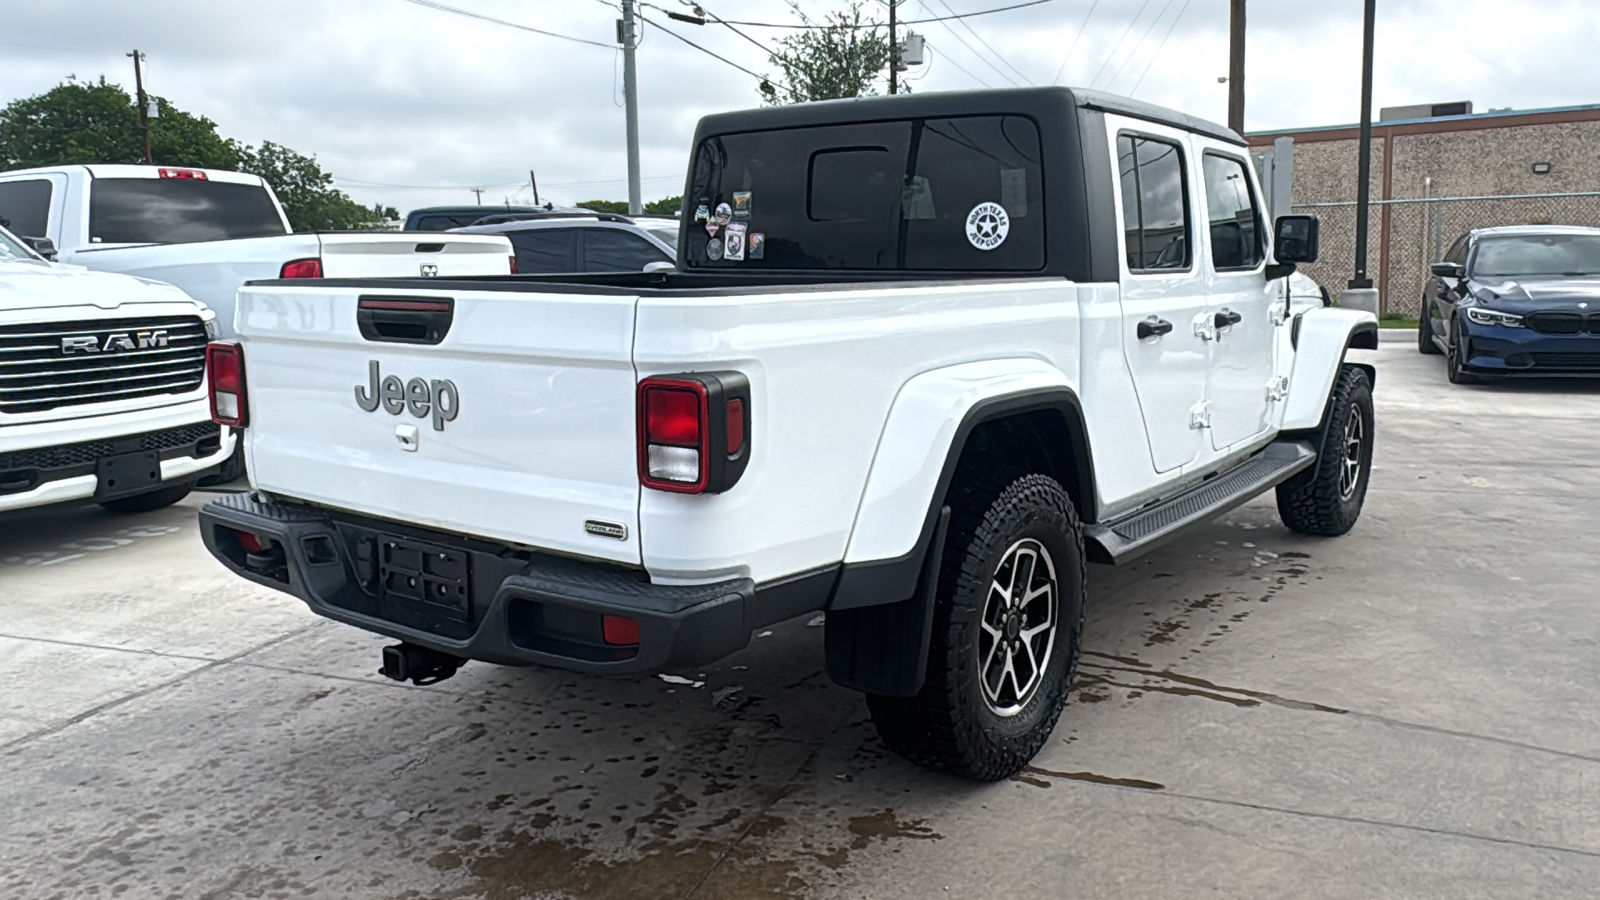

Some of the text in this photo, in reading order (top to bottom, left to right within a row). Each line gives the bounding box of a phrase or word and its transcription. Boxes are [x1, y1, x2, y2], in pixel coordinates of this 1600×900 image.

[969, 205, 1007, 226] NORTH TEXAS
[970, 232, 1002, 247] JEEP CLUB
[62, 330, 168, 354] RAM
[354, 360, 459, 431] Jeep
[584, 523, 624, 535] OVERLAND
